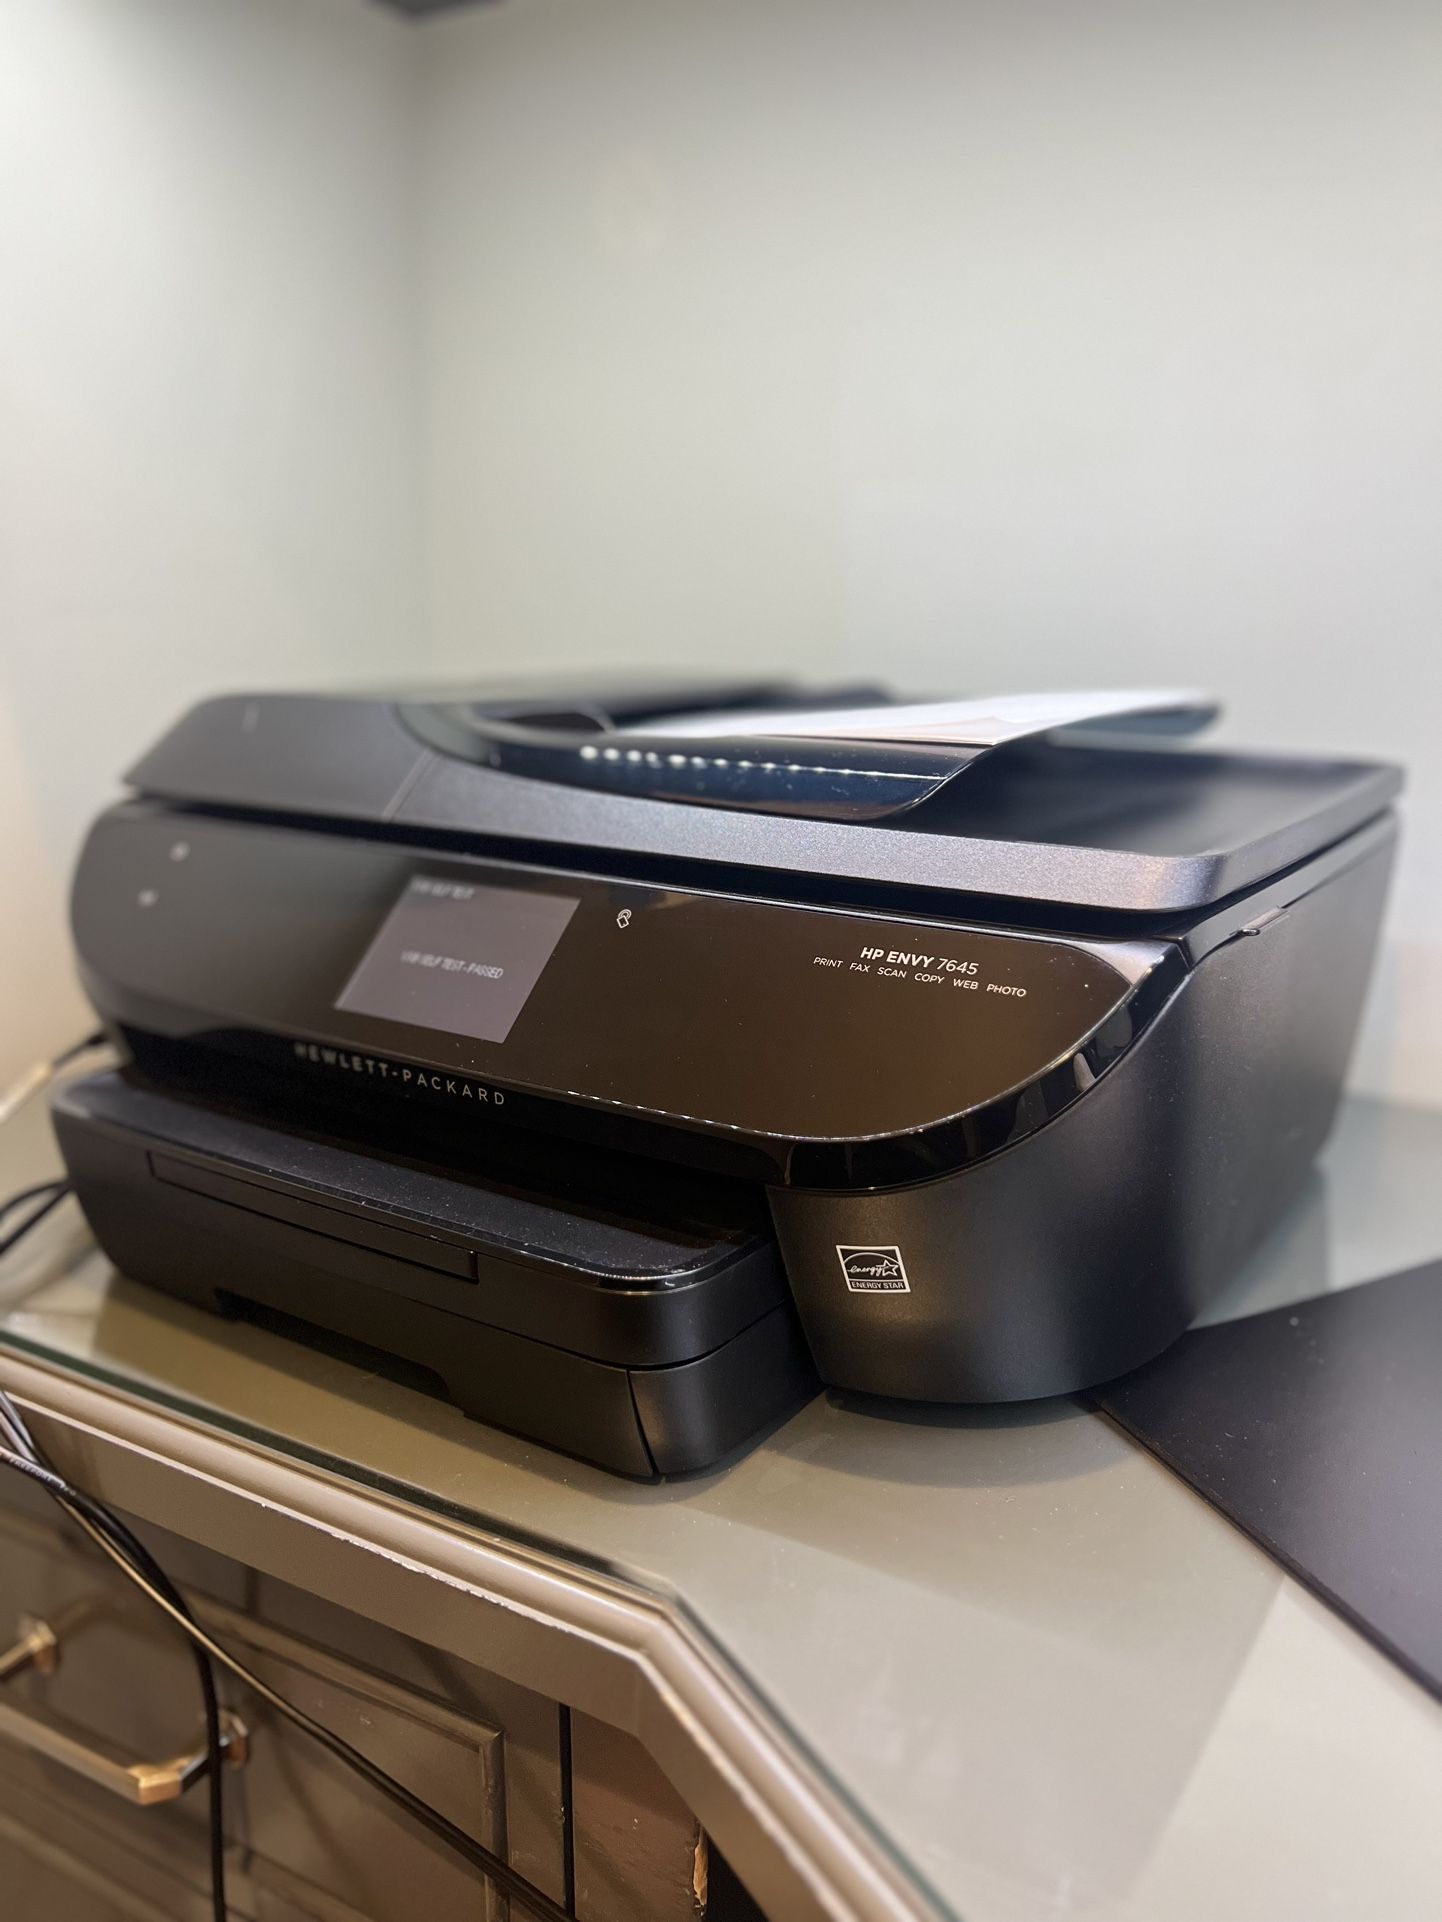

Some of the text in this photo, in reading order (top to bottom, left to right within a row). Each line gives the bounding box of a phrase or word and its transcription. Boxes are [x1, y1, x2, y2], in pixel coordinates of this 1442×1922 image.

[813, 956, 1027, 997] PRINT FAX SCAN COPY WEB PHOTO
[860, 947, 979, 975] HP ENVY 7645
[294, 1042, 505, 1105] HEWLETT-PACKARD
[851, 1281, 881, 1289] ENERGY
